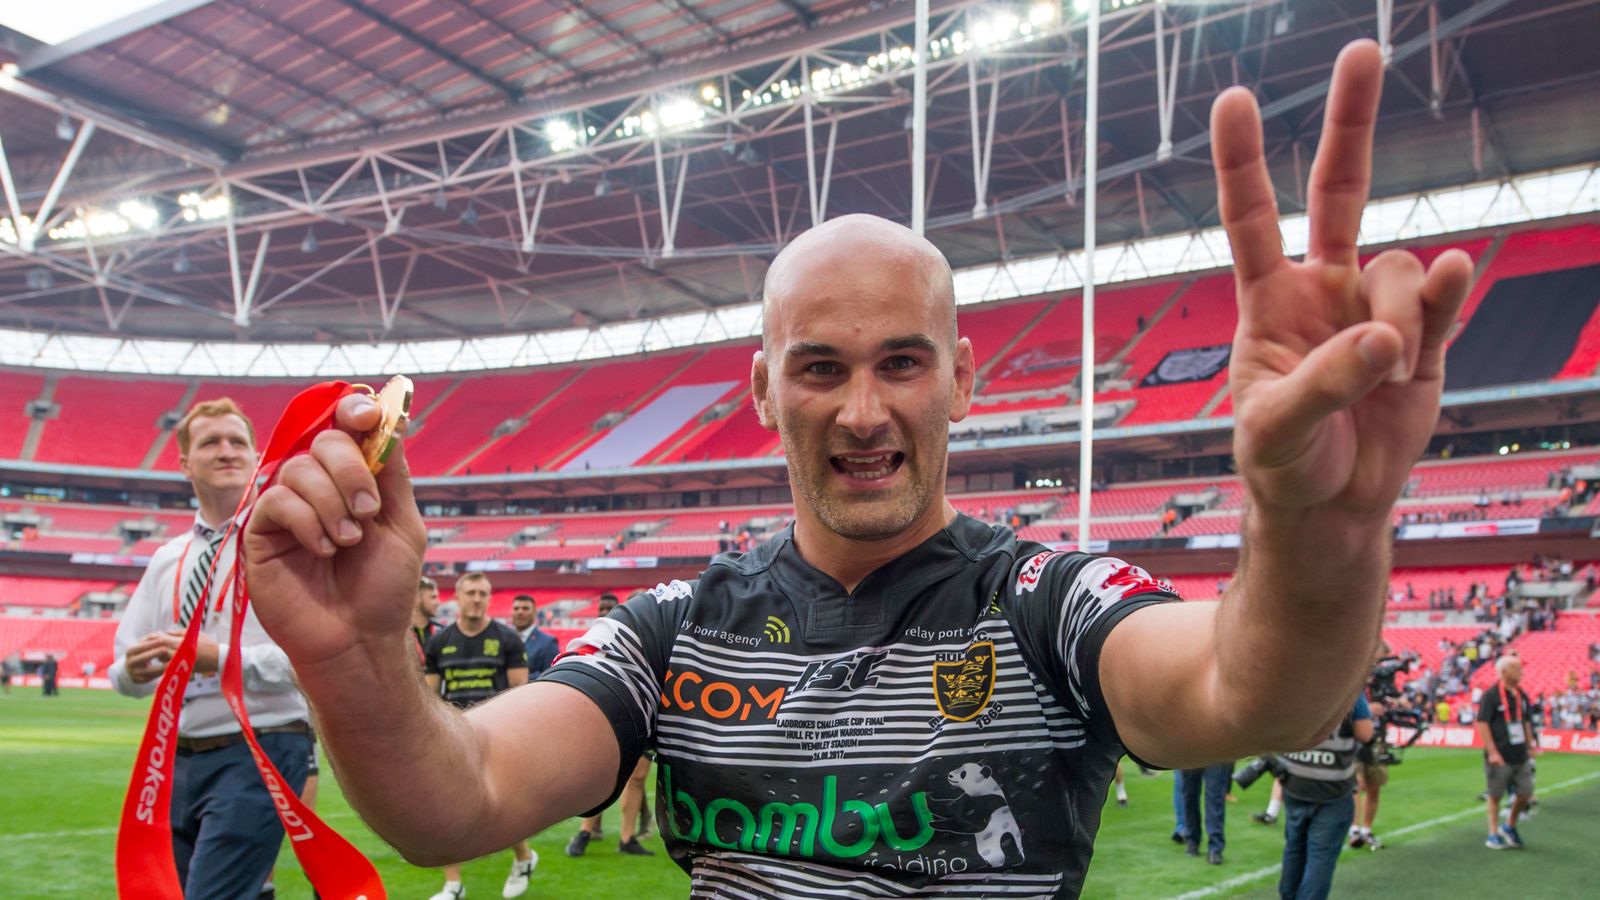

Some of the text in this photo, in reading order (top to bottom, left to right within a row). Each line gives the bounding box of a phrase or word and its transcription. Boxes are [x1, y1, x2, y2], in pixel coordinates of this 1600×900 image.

[694, 625, 762, 647] port agency
[905, 626, 963, 641] relay port
[790, 649, 891, 694] ISC
[776, 716, 884, 729] LADBROKES CHALLENGE CUP FINAL
[976, 701, 1003, 730] 1865
[136, 659, 189, 825] Ladbrokes
[786, 730, 803, 740] HULL
[805, 731, 814, 740] FC
[820, 729, 839, 740] WIGAN
[840, 727, 873, 737] WARRIORS
[800, 738, 858, 751] WEMBLEY STADIUM
[663, 764, 935, 857] bambu
